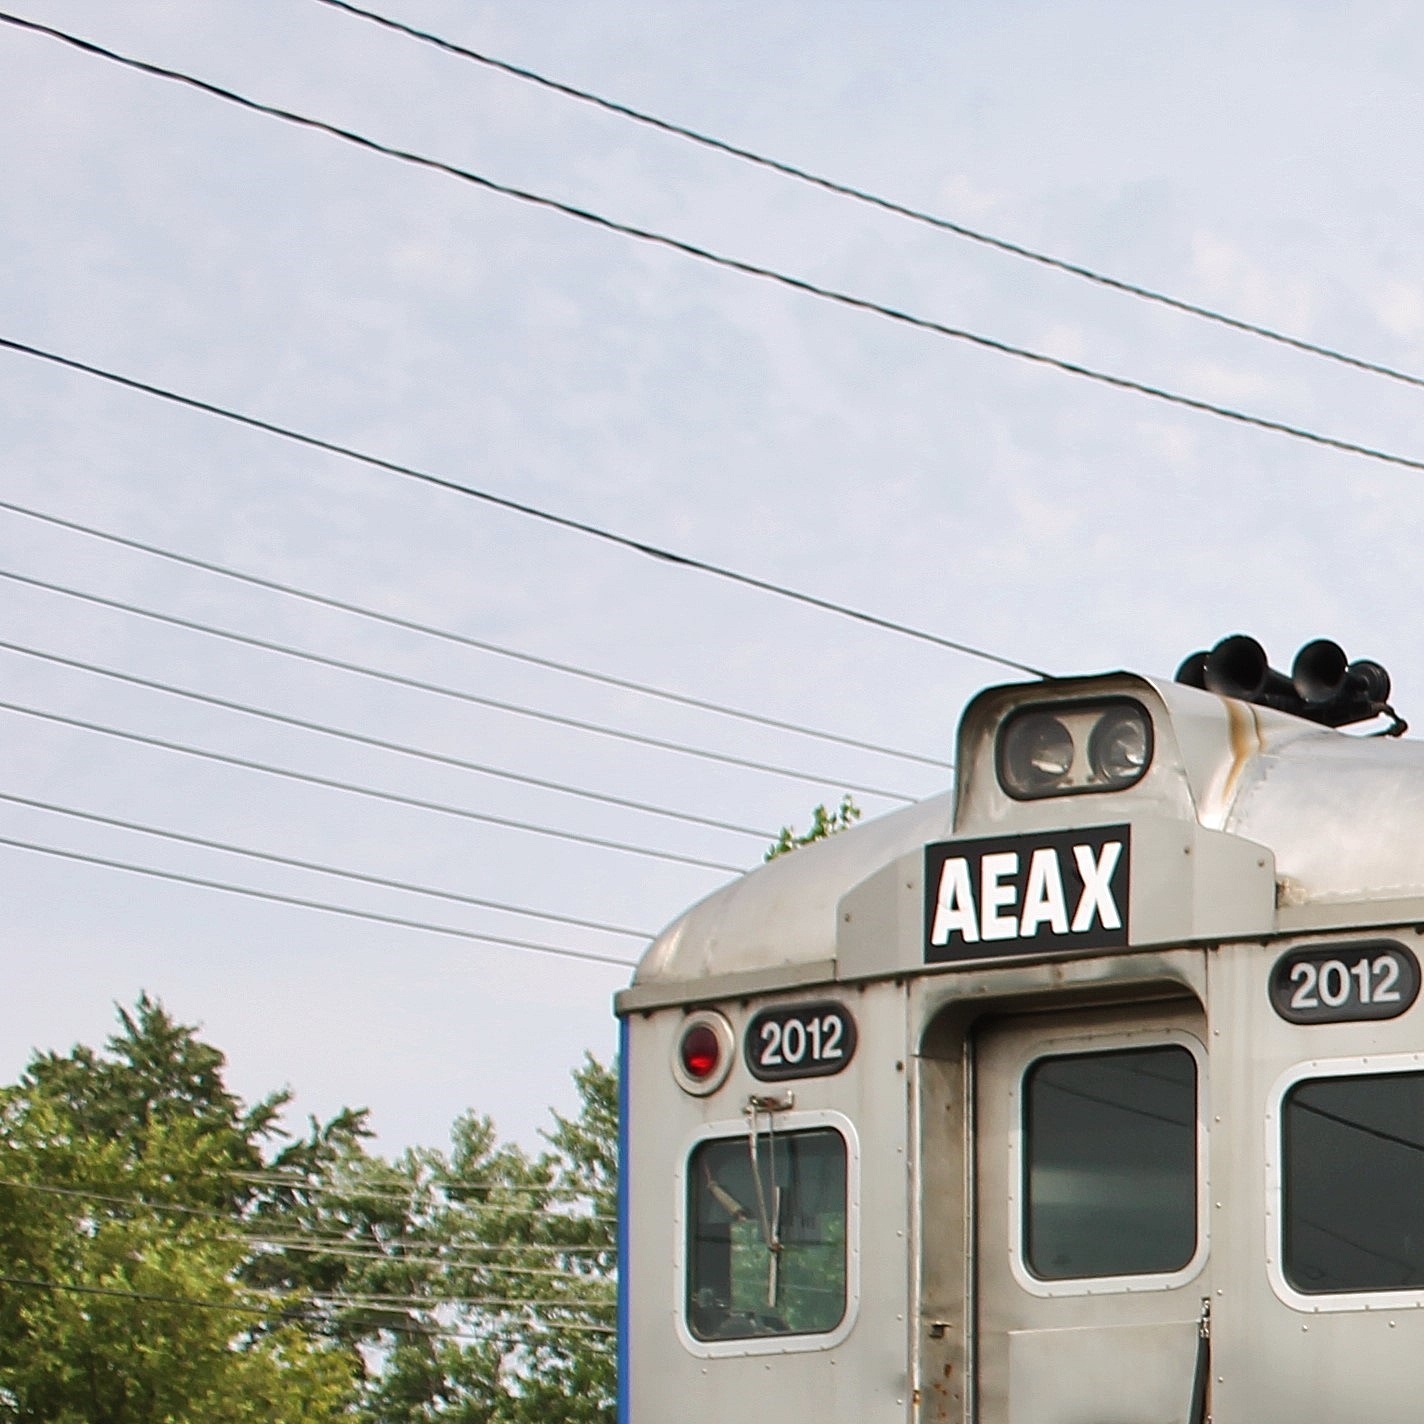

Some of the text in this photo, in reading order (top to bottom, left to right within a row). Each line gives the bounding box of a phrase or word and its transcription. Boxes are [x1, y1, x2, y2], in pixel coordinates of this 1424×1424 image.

[931, 841, 1122, 946] AEAX
[1289, 954, 1400, 1009] 2012
[759, 1014, 843, 1062] 2012
